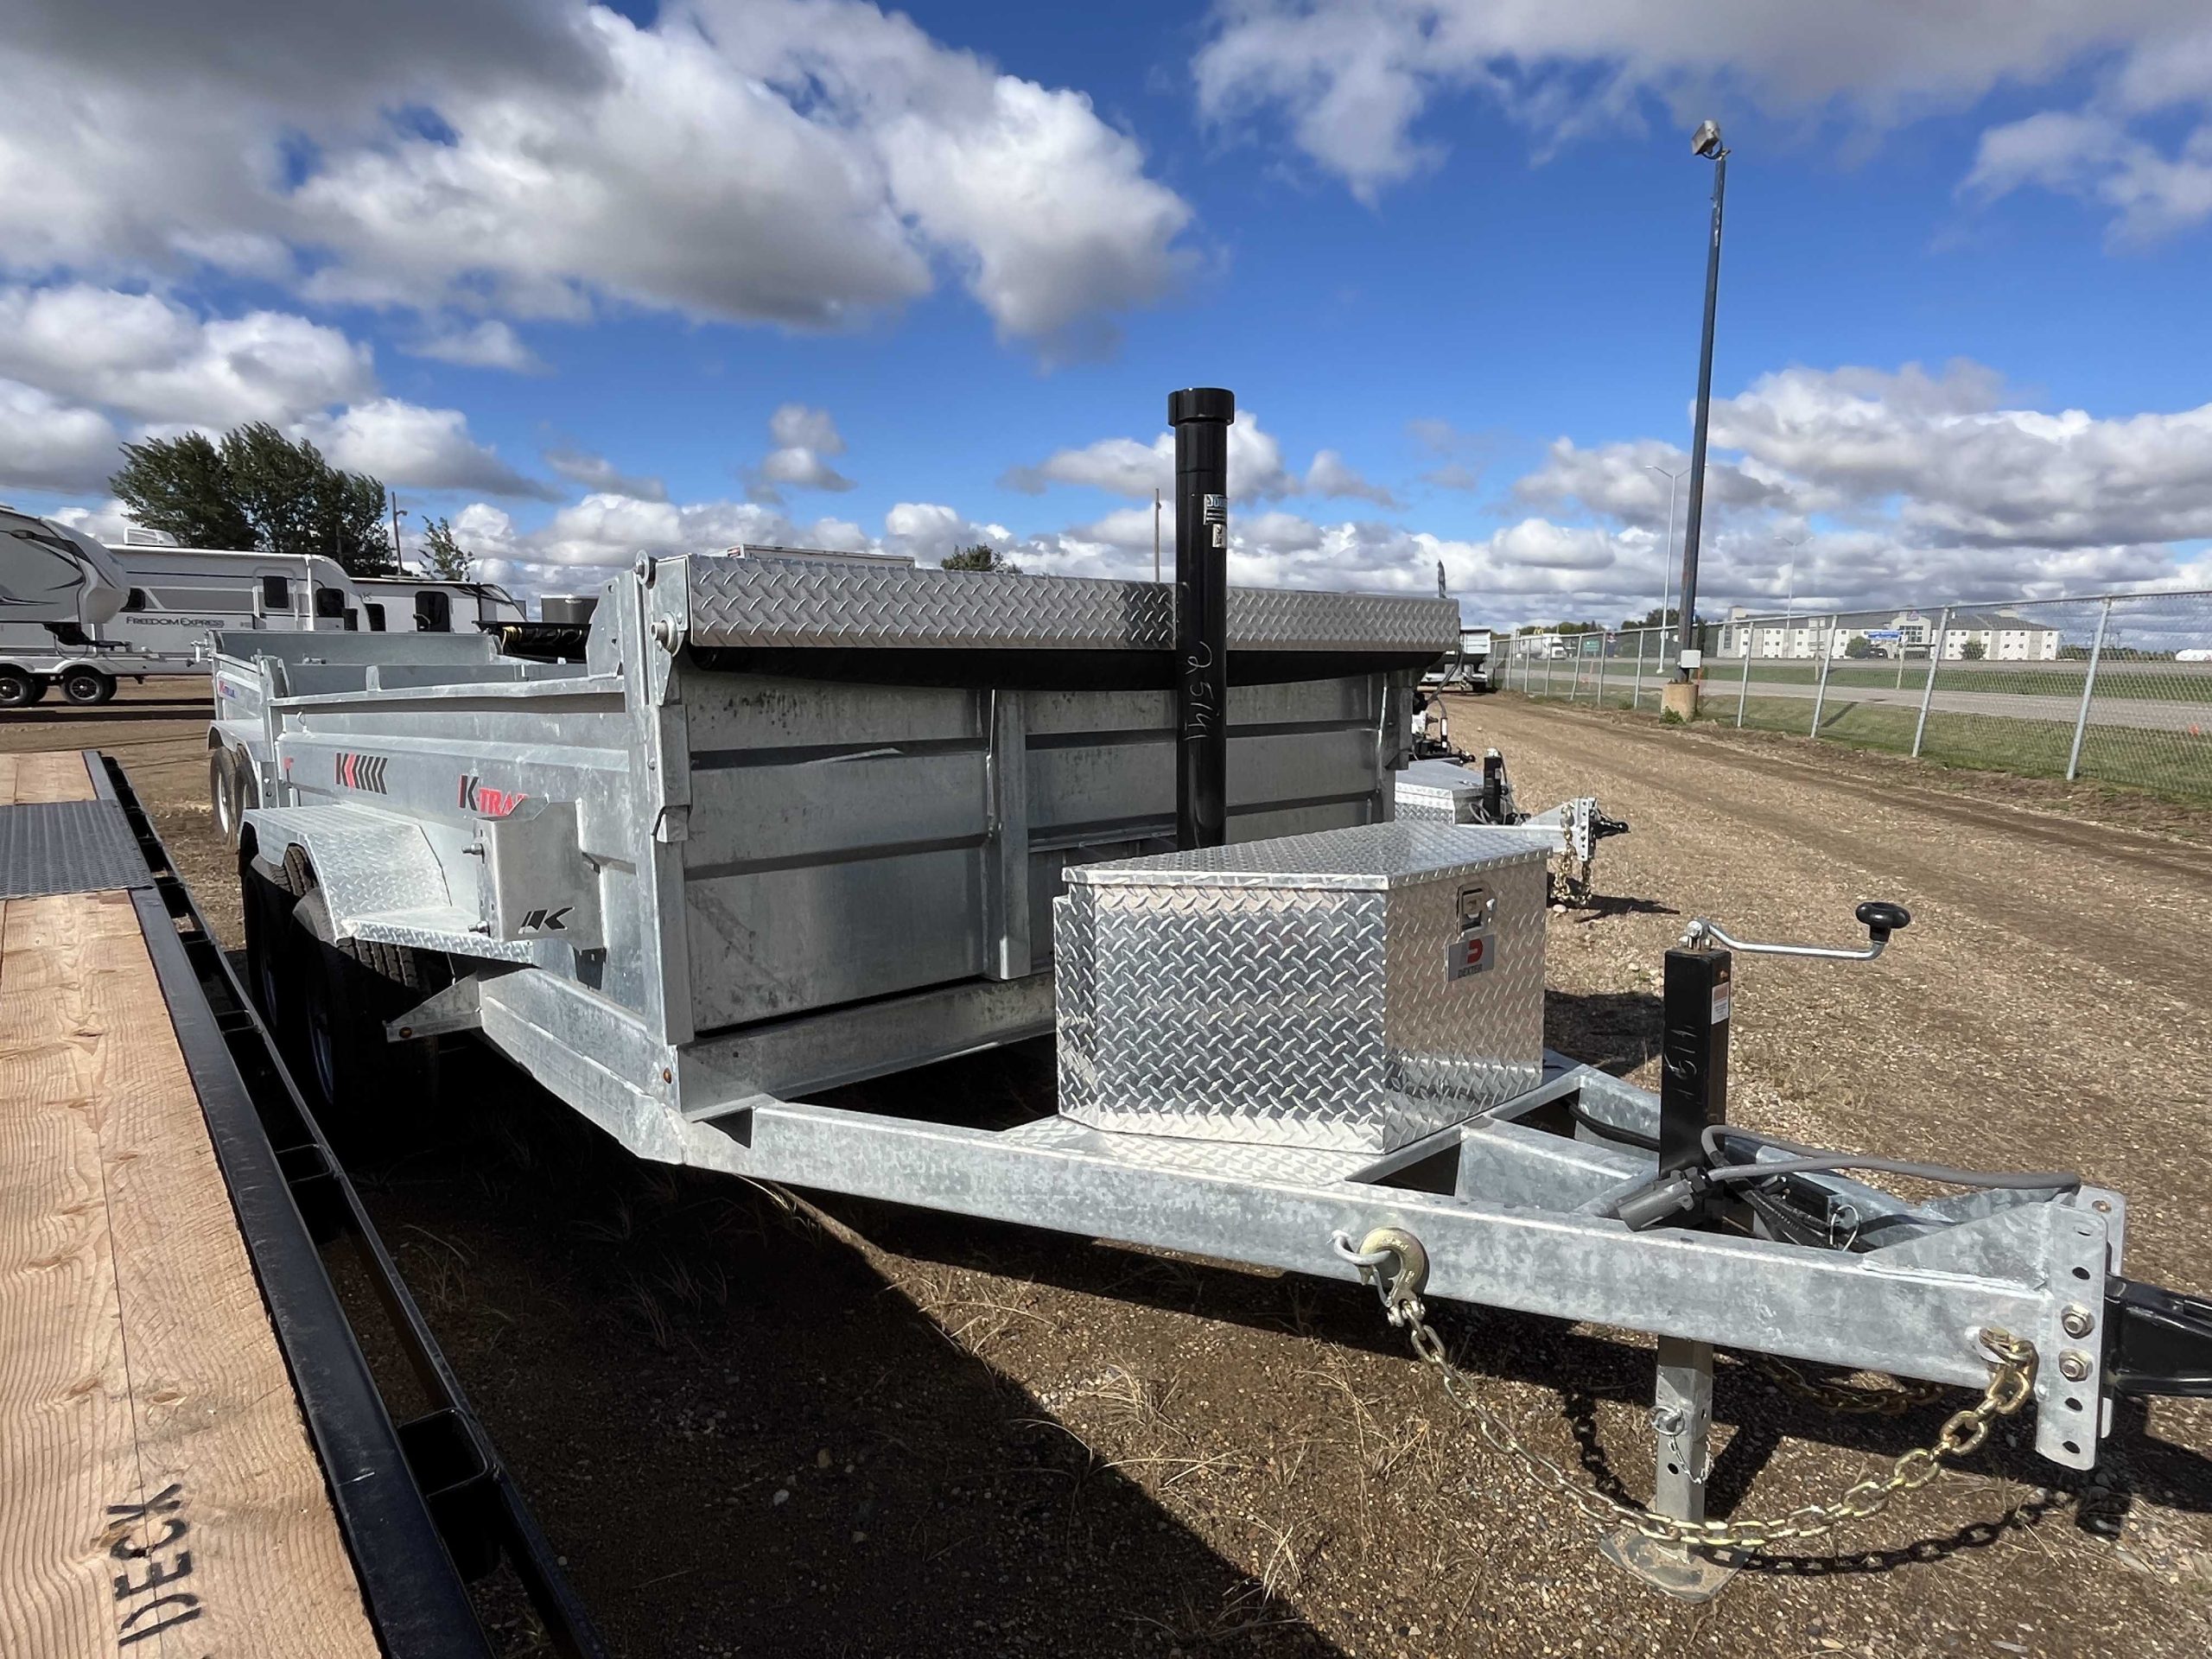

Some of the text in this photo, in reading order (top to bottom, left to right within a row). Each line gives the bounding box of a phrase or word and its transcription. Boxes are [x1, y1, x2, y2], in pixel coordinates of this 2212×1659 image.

[126, 616, 225, 628] FREEDOM EXPRESS
[106, 1484, 202, 1647] DECK
